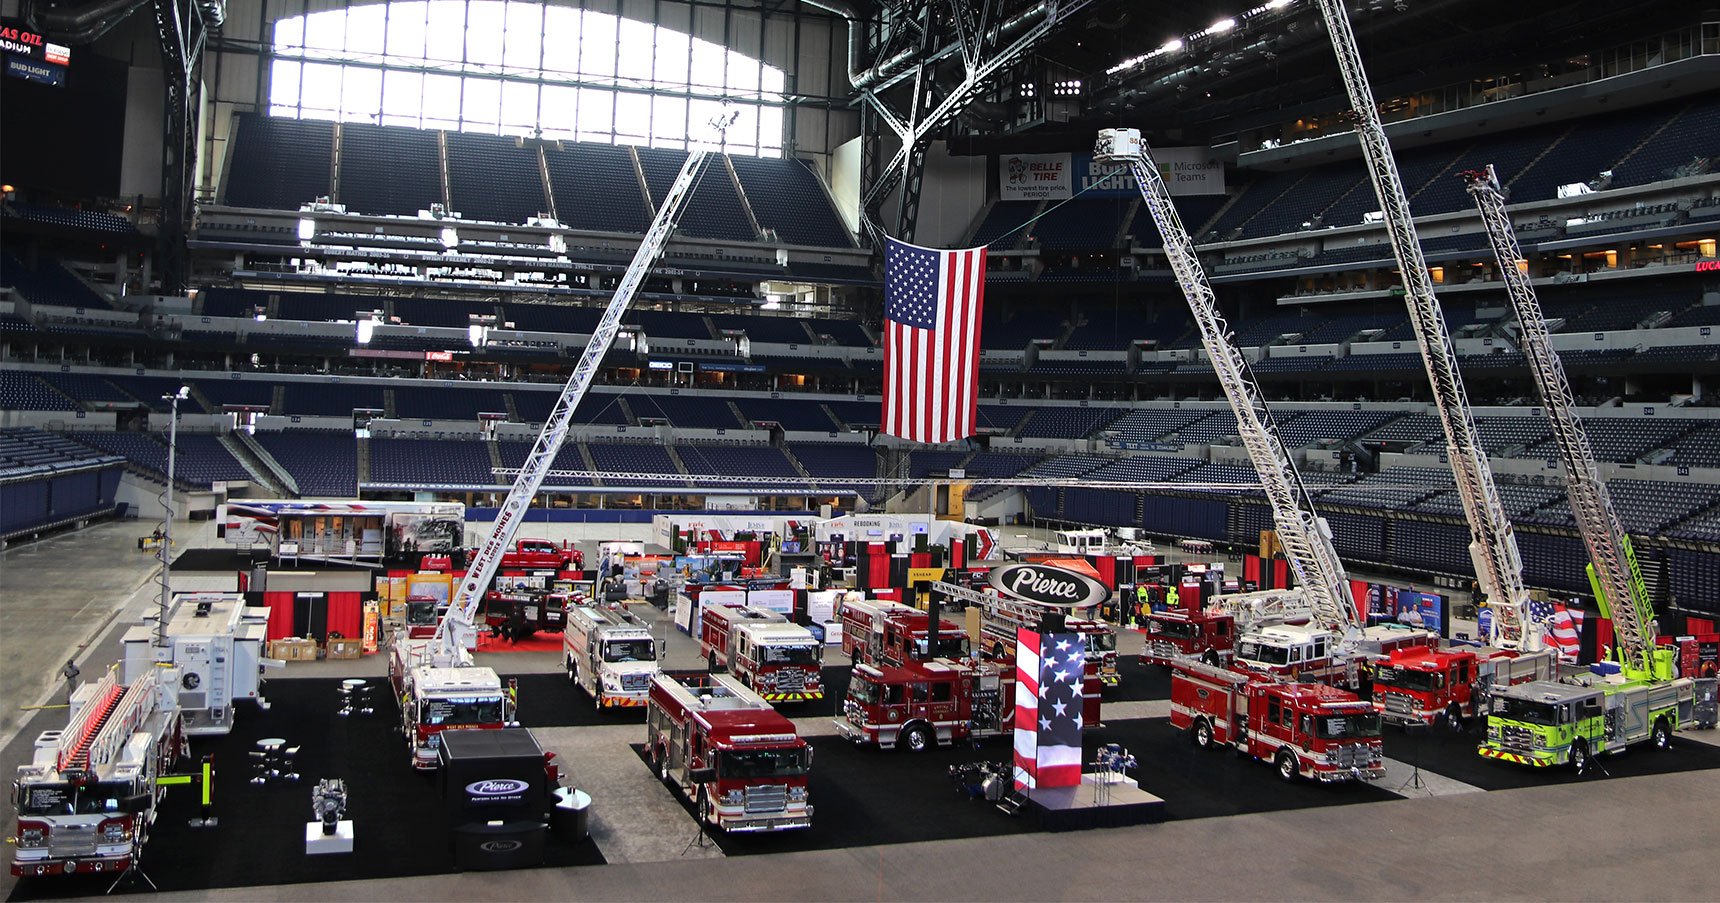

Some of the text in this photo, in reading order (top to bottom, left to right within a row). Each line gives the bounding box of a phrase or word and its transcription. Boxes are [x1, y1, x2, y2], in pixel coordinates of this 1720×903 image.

[21, 31, 42, 46] OIL
[10, 61, 50, 77] BUD LIGHT
[1029, 162, 1063, 171] BELLE
[1174, 161, 1219, 171] Microsoft
[1033, 172, 1058, 181] TIRE
[1175, 173, 1206, 182] Teams
[471, 510, 512, 579] WEST DES MOINES
[1012, 568, 1077, 598] Pierce
[1629, 553, 1653, 616] MIAMI-DADE
[480, 781, 514, 792] Pierce
